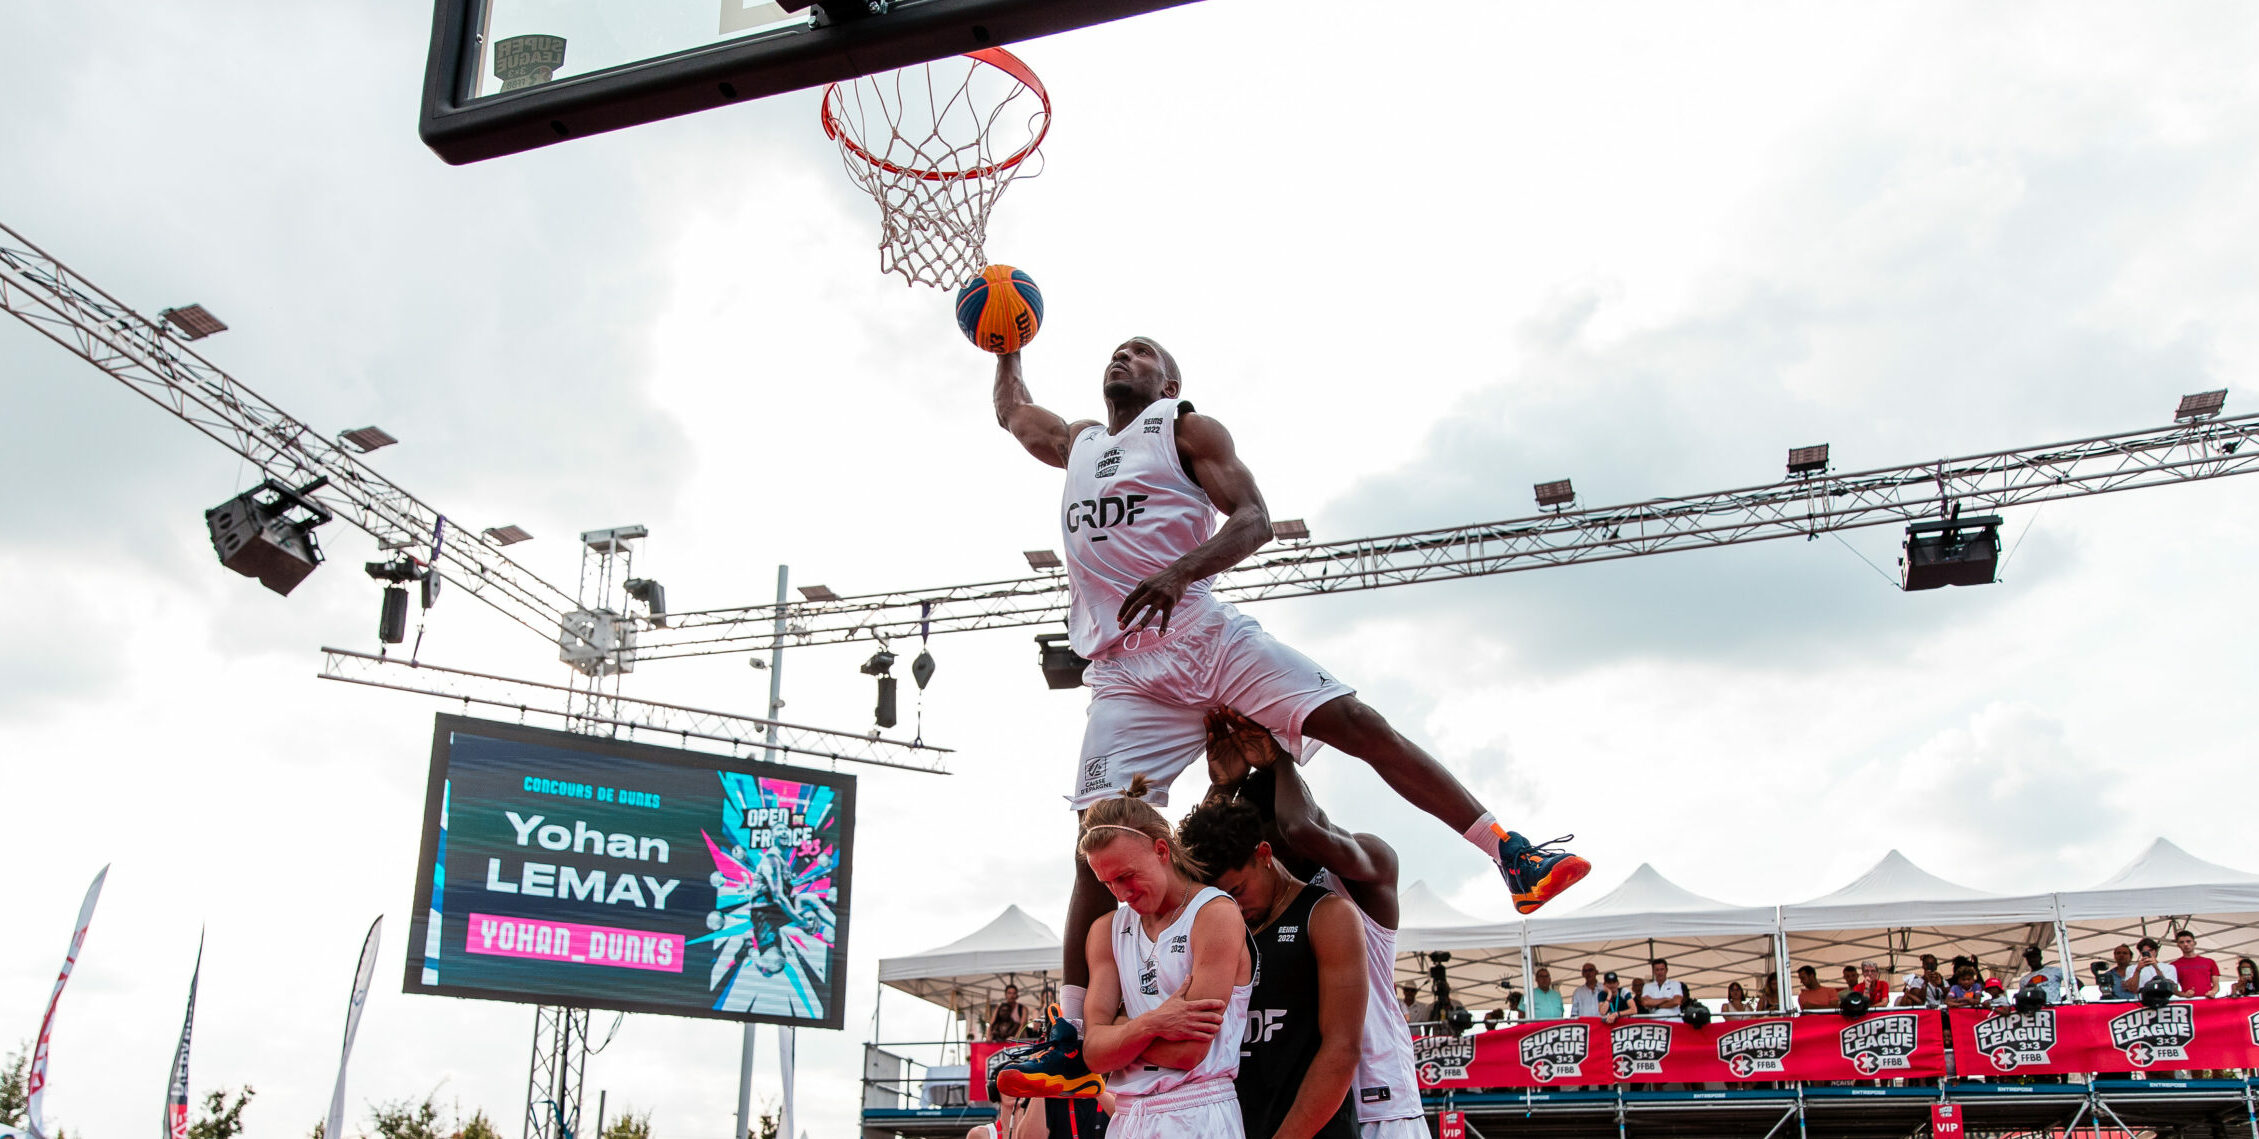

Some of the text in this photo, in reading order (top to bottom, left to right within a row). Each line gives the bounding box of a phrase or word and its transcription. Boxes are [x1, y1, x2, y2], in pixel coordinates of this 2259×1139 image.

[1067, 495, 1148, 533] GRDF
[524, 776, 661, 809] CONCOURS DE DUNKS
[1085, 778, 1105, 787] CAISSE
[747, 808, 790, 828] OPEN
[505, 810, 670, 863] Yohan
[486, 858, 681, 910] LEMAY
[1278, 926, 1299, 934] REIMS
[1278, 935, 1295, 943] 2022
[481, 919, 674, 966] YOHAN_DUNKS
[1844, 1017, 1913, 1043] SUPER
[1978, 1011, 2051, 1038] SUPER
[2112, 1006, 2188, 1034] SUPER
[1522, 1026, 1585, 1051] SUPER
[1611, 1026, 1668, 1043] UPER
[1721, 1024, 1787, 1046] SUPER
[1845, 1033, 1913, 1054] LEAGUE
[1980, 1027, 2052, 1050] LEAGUE
[2115, 1023, 2191, 1045] LEAGUE
[1523, 1041, 1585, 1062] LEAGUE
[1613, 1039, 1667, 1054] EAGUE
[1721, 1037, 1787, 1057] LEAGUE
[2157, 1049, 2179, 1057] FFBB
[1636, 1062, 1655, 1070] FFBB
[1882, 1058, 1903, 1066] FFBB
[2020, 1053, 2042, 1062] FFBB
[1444, 1069, 1461, 1077] FFBB
[1556, 1066, 1574, 1074] FFBB
[1443, 1129, 1462, 1138] VIP
[1937, 1123, 1959, 1132] VIP
